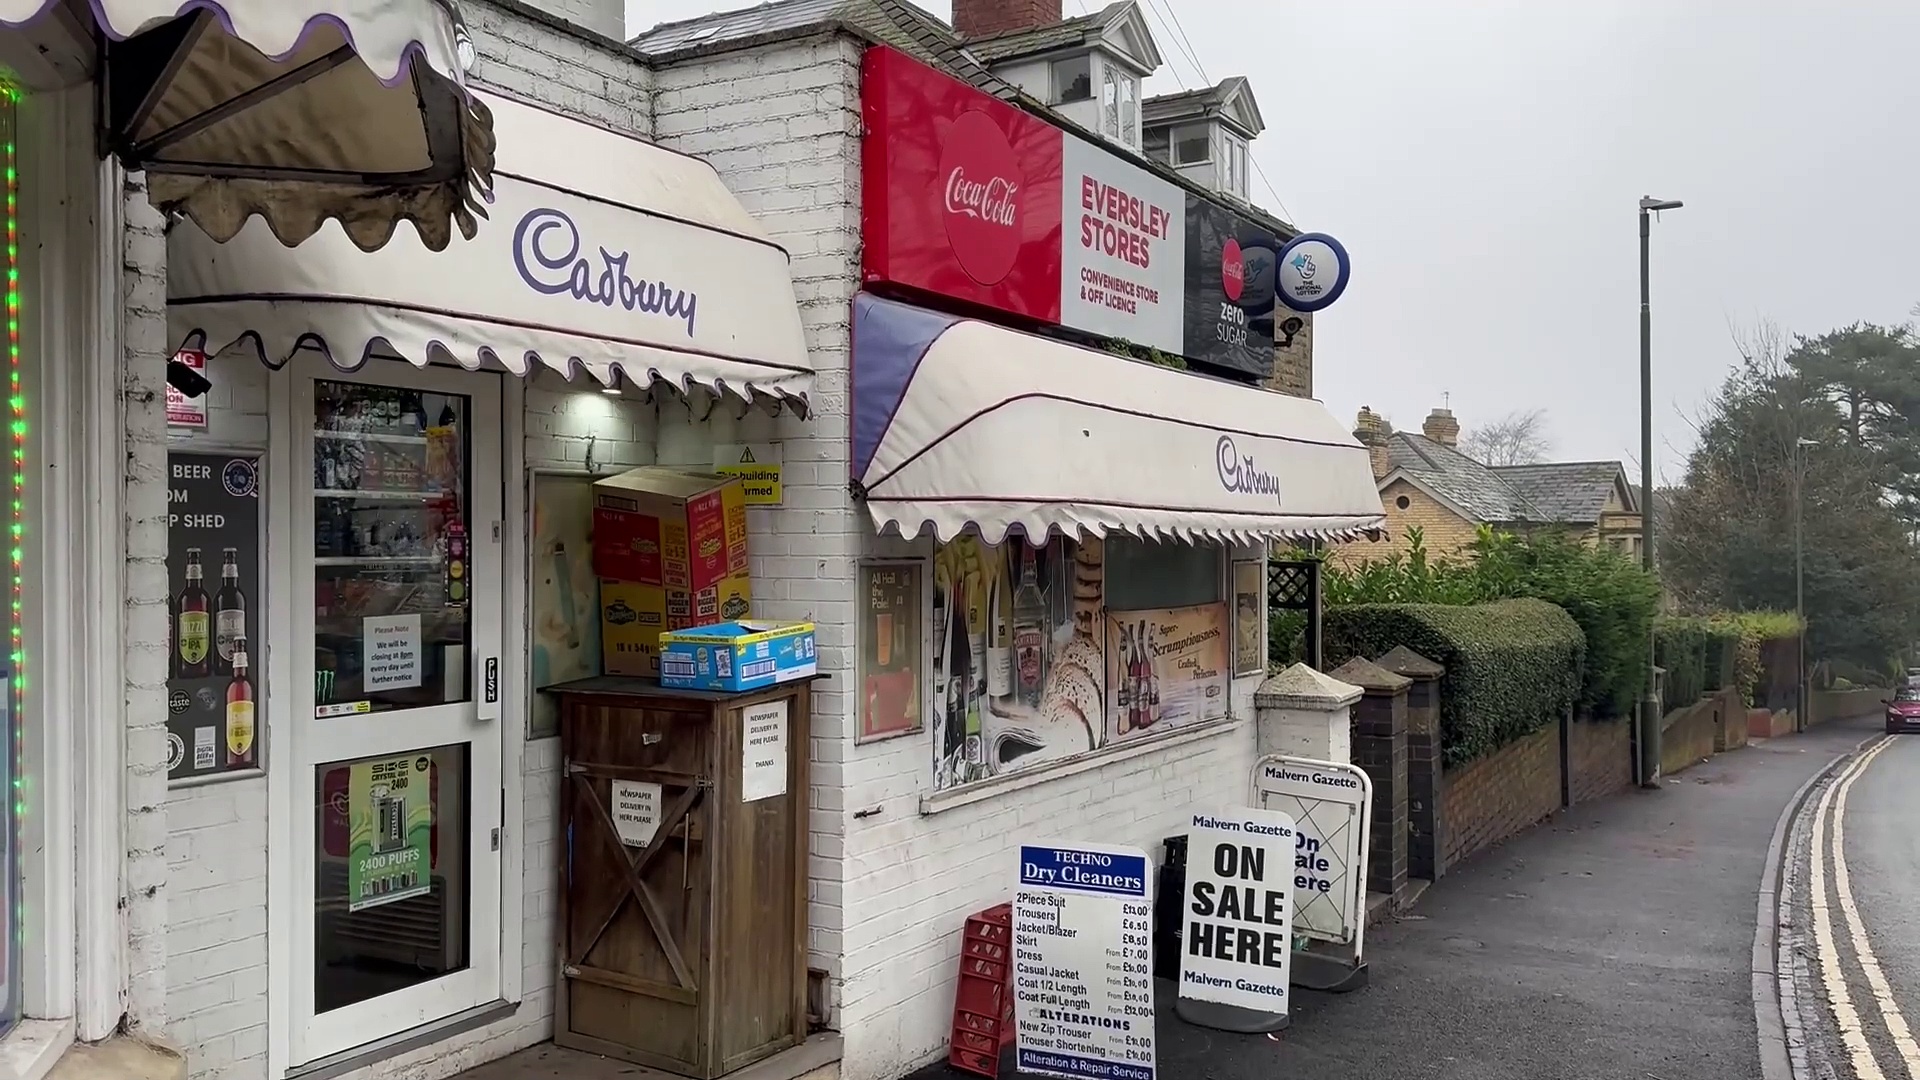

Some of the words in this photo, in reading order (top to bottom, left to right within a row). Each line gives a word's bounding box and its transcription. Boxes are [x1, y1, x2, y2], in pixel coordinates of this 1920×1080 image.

[945, 166, 1018, 226] Coca-Cola
[1082, 174, 1170, 240] EVERSLEY
[1081, 213, 1150, 269] STORES
[513, 207, 696, 338] Cadbury
[1081, 267, 1135, 296] CONVENIENCE
[1136, 285, 1158, 304] STORE
[1080, 286, 1086, 300] &
[1088, 287, 1103, 304] OFF
[1105, 293, 1136, 315] LICENCE
[1220, 302, 1244, 326] zero
[1217, 323, 1247, 347] SUGAR
[173, 464, 211, 479] BEER
[740, 471, 778, 482] building
[1216, 435, 1281, 507] Cadbury
[168, 489, 188, 503] OM
[744, 485, 772, 496] rmed
[184, 514, 225, 528] SHED
[188, 638, 201, 649] IPA
[388, 640, 399, 648] will
[371, 653, 391, 661] closing
[400, 661, 414, 669] until
[372, 675, 393, 684] further
[394, 673, 412, 681] notice
[487, 660, 496, 700] PUSH
[169, 698, 190, 707] taste
[750, 712, 778, 721] NEWSPAPER
[750, 725, 772, 733] DELIVERY
[750, 737, 762, 746] HERE
[763, 735, 778, 744] PLEASE
[755, 759, 774, 768] THANKS
[372, 772, 396, 781] CRYSTAL
[391, 777, 408, 790] 2400
[1265, 767, 1309, 782] Malvern
[1312, 773, 1357, 789] Gazette
[620, 789, 652, 800] NEWSPAPER
[620, 802, 644, 811] DELIVERY
[619, 814, 632, 822] HERE
[633, 815, 651, 824] PLEASE
[1193, 815, 1240, 832] Malvern
[1244, 821, 1292, 837] Gazette
[625, 838, 646, 847] THANKS
[1295, 832, 1319, 852] On
[360, 855, 385, 872] 2400
[389, 848, 420, 865] PUFFS
[1054, 851, 1111, 867] TECHNO
[1214, 843, 1265, 882] ON
[1295, 852, 1329, 872] ale
[1025, 863, 1056, 884] Dry
[1061, 866, 1141, 889] Cleaners
[1294, 875, 1331, 892] ere
[1017, 892, 1046, 905] 2Piece
[1048, 895, 1066, 908] Suit
[1191, 881, 1284, 926] SALE
[1016, 907, 1055, 921] Trousers
[1016, 921, 1077, 938] Jacket/Blazer
[1122, 918, 1148, 931] £6.50
[1016, 934, 1037, 946] Skirt
[1122, 933, 1148, 946] £8.50
[1189, 921, 1283, 969] HERE
[1017, 949, 1042, 961] Dress
[1105, 948, 1121, 957] From
[1017, 963, 1048, 976] Casual
[1050, 967, 1079, 980] Jacket
[1106, 962, 1121, 971] From
[1018, 977, 1038, 988] Coat
[1041, 979, 1053, 991] 1/2
[1055, 982, 1087, 996] Length
[1107, 976, 1121, 986] From
[1184, 970, 1232, 988] Malvern
[1236, 978, 1284, 997] Gazette
[1018, 991, 1039, 1002] Coat
[1041, 993, 1057, 1005] Full
[1059, 996, 1090, 1010] Length
[1107, 991, 1123, 1000] From
[1108, 1005, 1123, 1014] From
[1039, 1009, 1130, 1031] ALTERATIONS
[1019, 1020, 1039, 1032] New
[1041, 1022, 1055, 1036] Zip
[1058, 1025, 1091, 1039] Trouser
[1020, 1034, 1054, 1048] Trouser
[1056, 1037, 1106, 1057] Shortening
[1109, 1035, 1124, 1044] From
[1109, 1049, 1124, 1058] From
[1023, 1052, 1068, 1068] Alteration
[1070, 1060, 1078, 1069] &
[1079, 1061, 1110, 1076] Repair
[1112, 1065, 1149, 1080] Service
